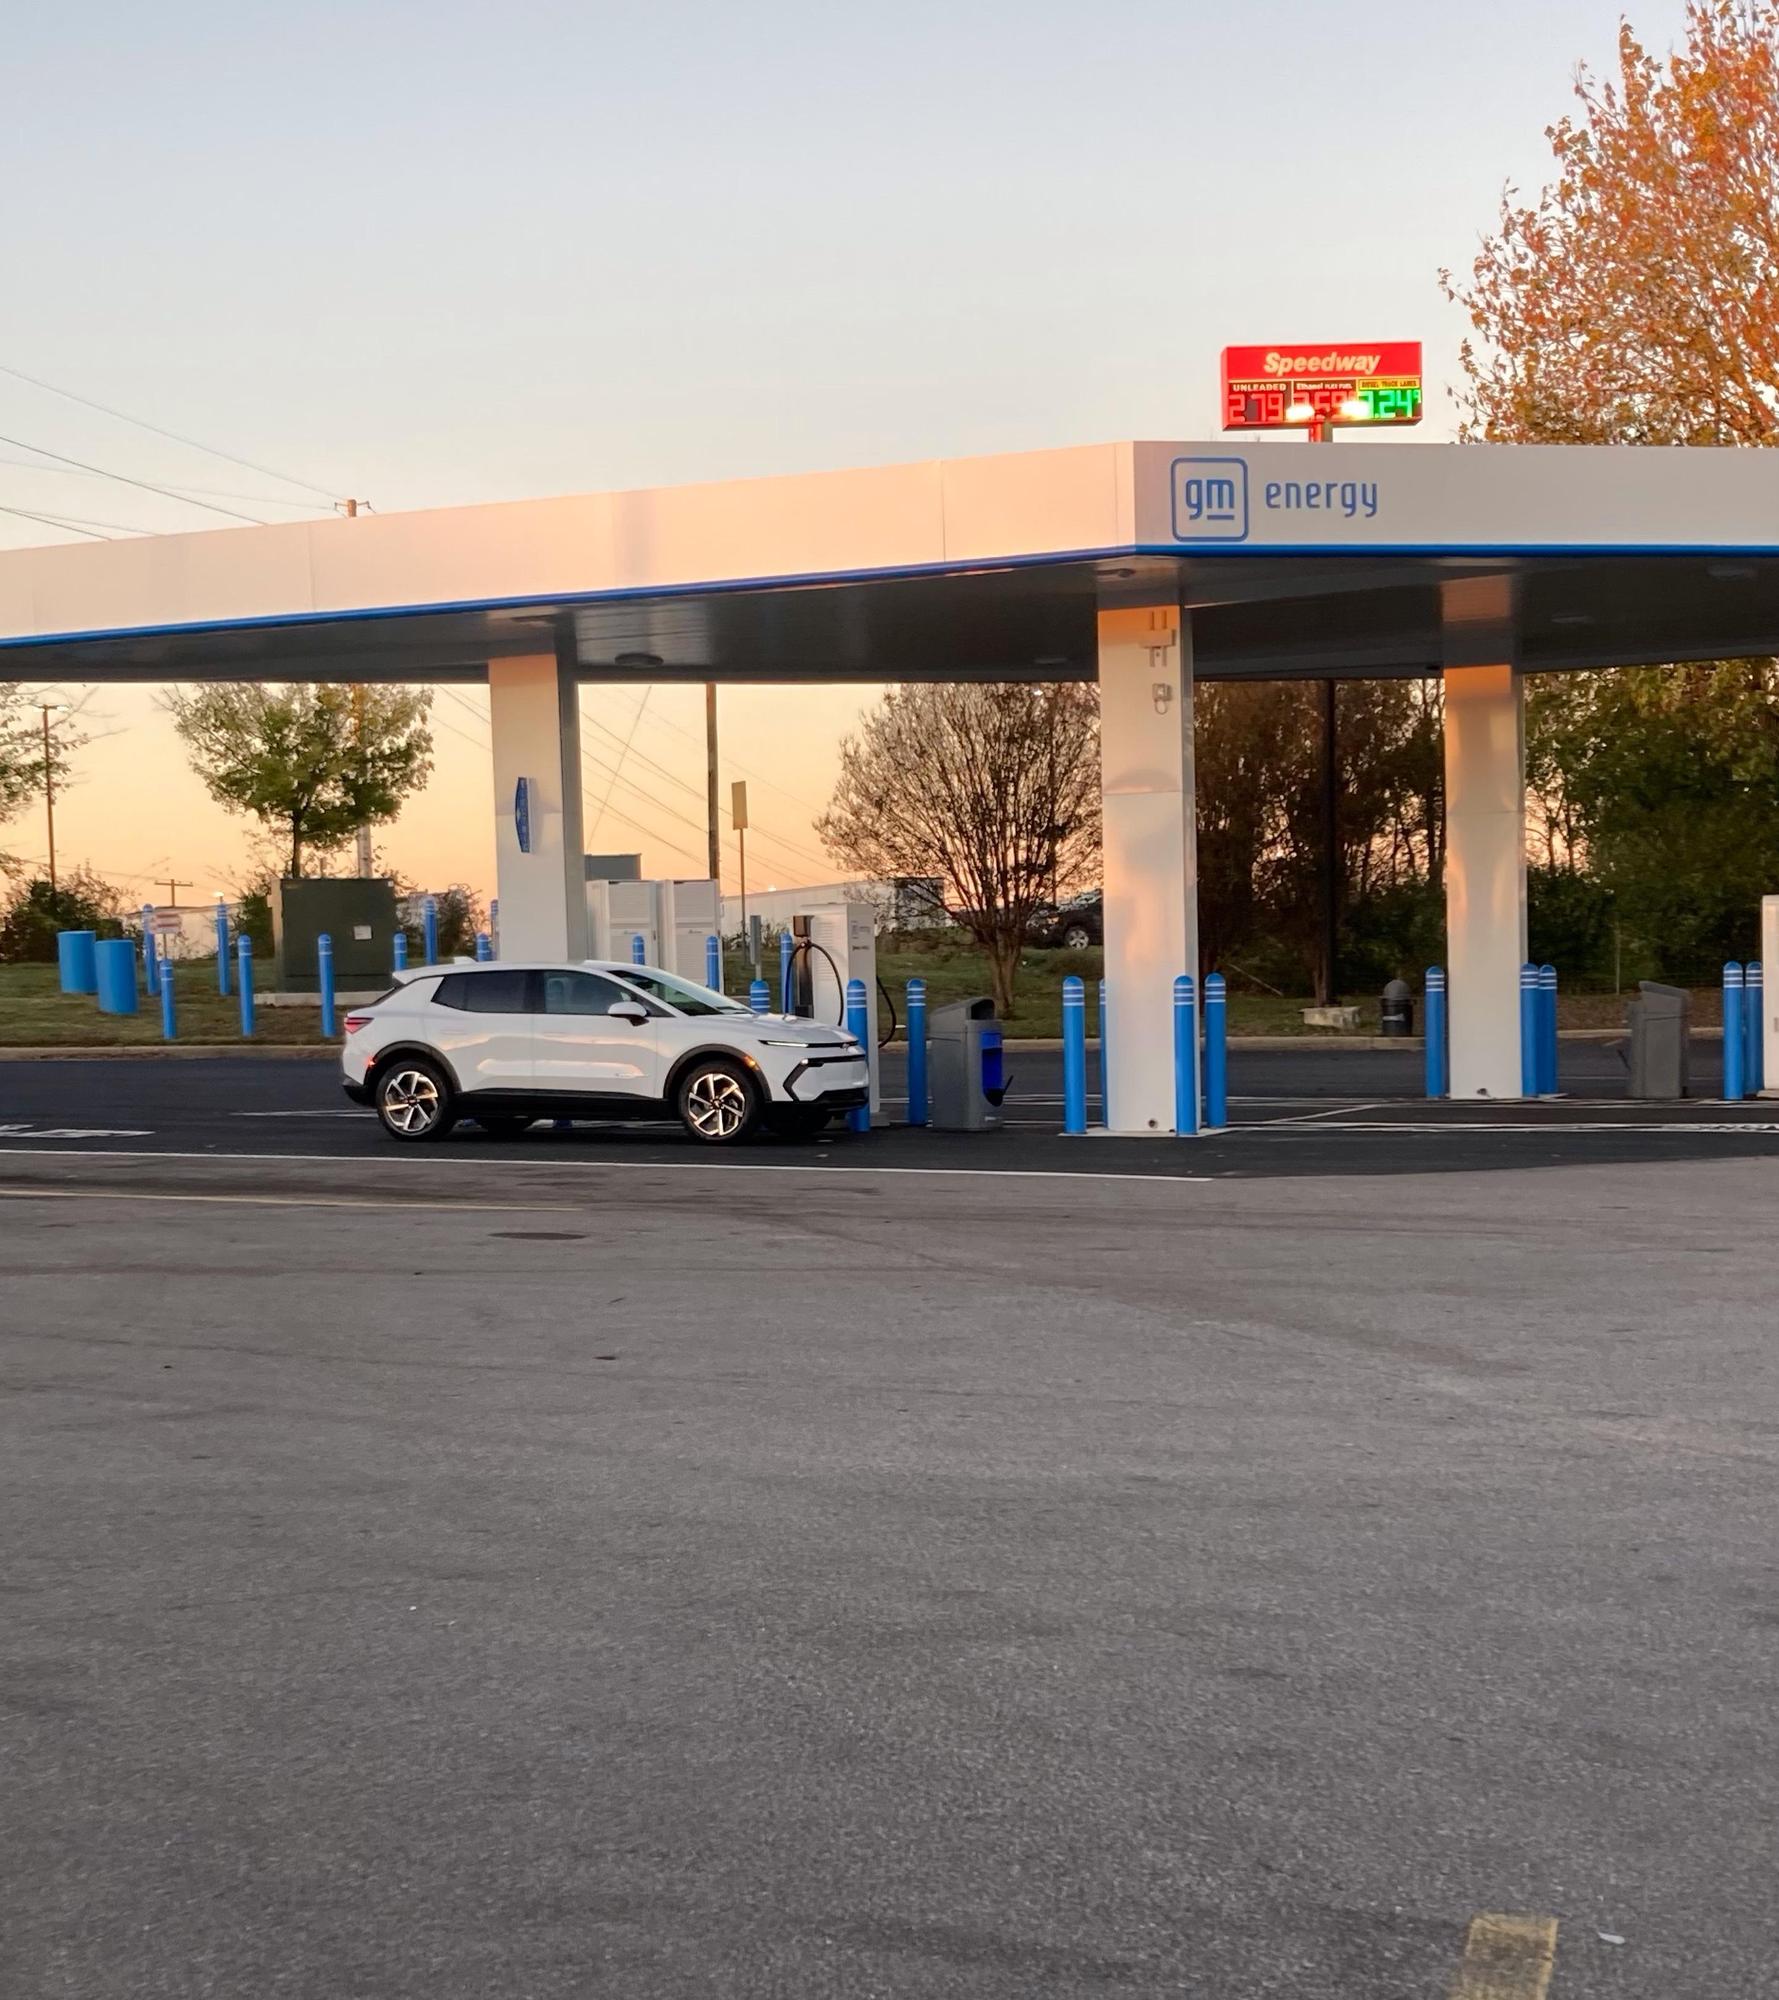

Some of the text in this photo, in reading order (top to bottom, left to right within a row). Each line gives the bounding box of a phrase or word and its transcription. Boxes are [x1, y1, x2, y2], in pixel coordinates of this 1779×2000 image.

[1263, 352, 1381, 376] Speedway
[1232, 383, 1287, 392] UNLEADED
[1185, 479, 1378, 521] gm energy
